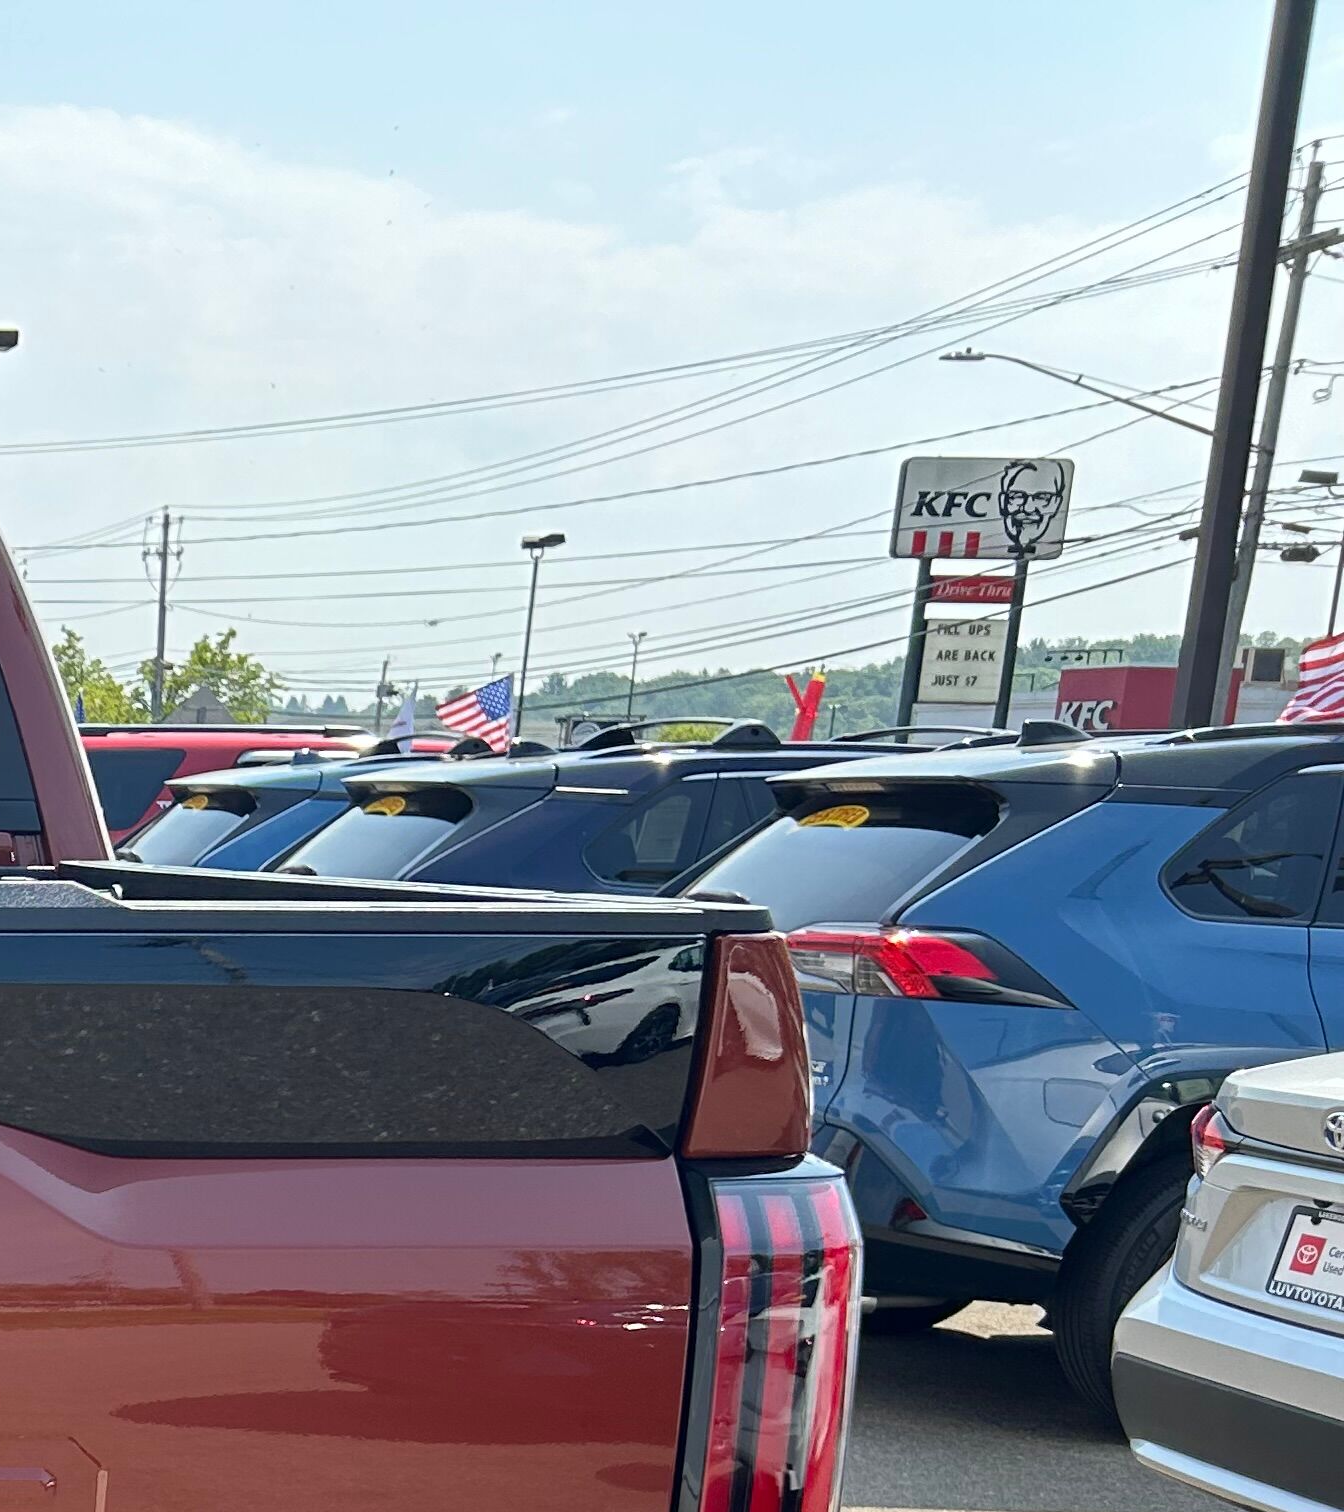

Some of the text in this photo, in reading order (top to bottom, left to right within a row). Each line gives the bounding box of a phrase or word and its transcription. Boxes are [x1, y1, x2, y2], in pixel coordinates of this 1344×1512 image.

[910, 491, 992, 517] KFC
[976, 583, 1012, 597] Thru
[969, 624, 992, 635] UPS
[936, 650, 996, 661] ARE BACK
[931, 674, 978, 687] JUST $7
[1058, 700, 1114, 730] KFC
